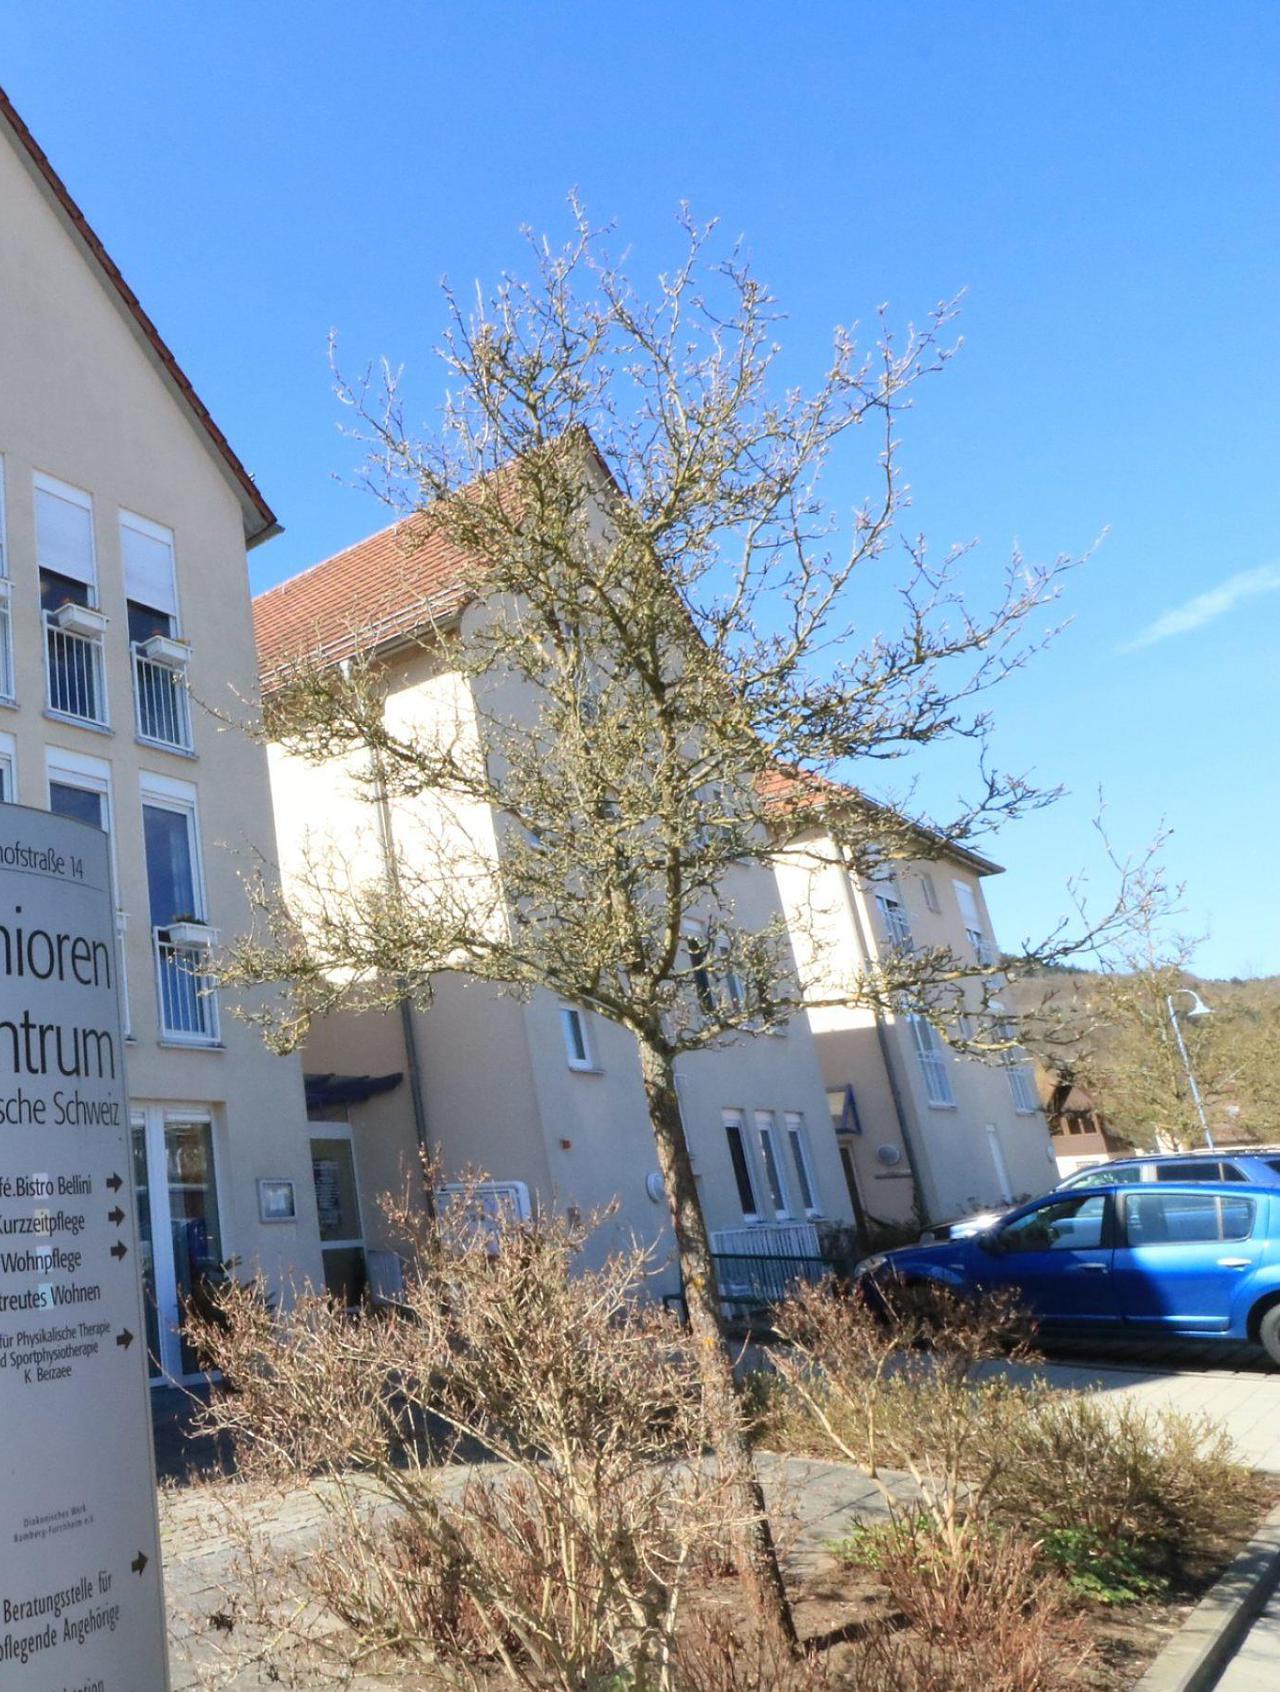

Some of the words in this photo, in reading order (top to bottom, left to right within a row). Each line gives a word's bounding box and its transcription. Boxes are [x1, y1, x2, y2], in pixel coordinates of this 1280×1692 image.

[70, 855, 84, 879] 14
[54, 1091, 120, 1126] Schweiz
[58, 1173, 92, 1195] Bellini
[0, 1247, 82, 1275] Wohnpflege
[50, 1283, 101, 1306] Wohnen
[0, 1333, 13, 1347] für
[16, 1325, 76, 1348] Physikalische
[78, 1318, 111, 1336] Therapie
[9, 1341, 99, 1369] Sportphysiotherapie
[3, 1576, 93, 1624] Beratungsstelle
[98, 1570, 112, 1594] für
[63, 1602, 120, 1645] Angehörige
